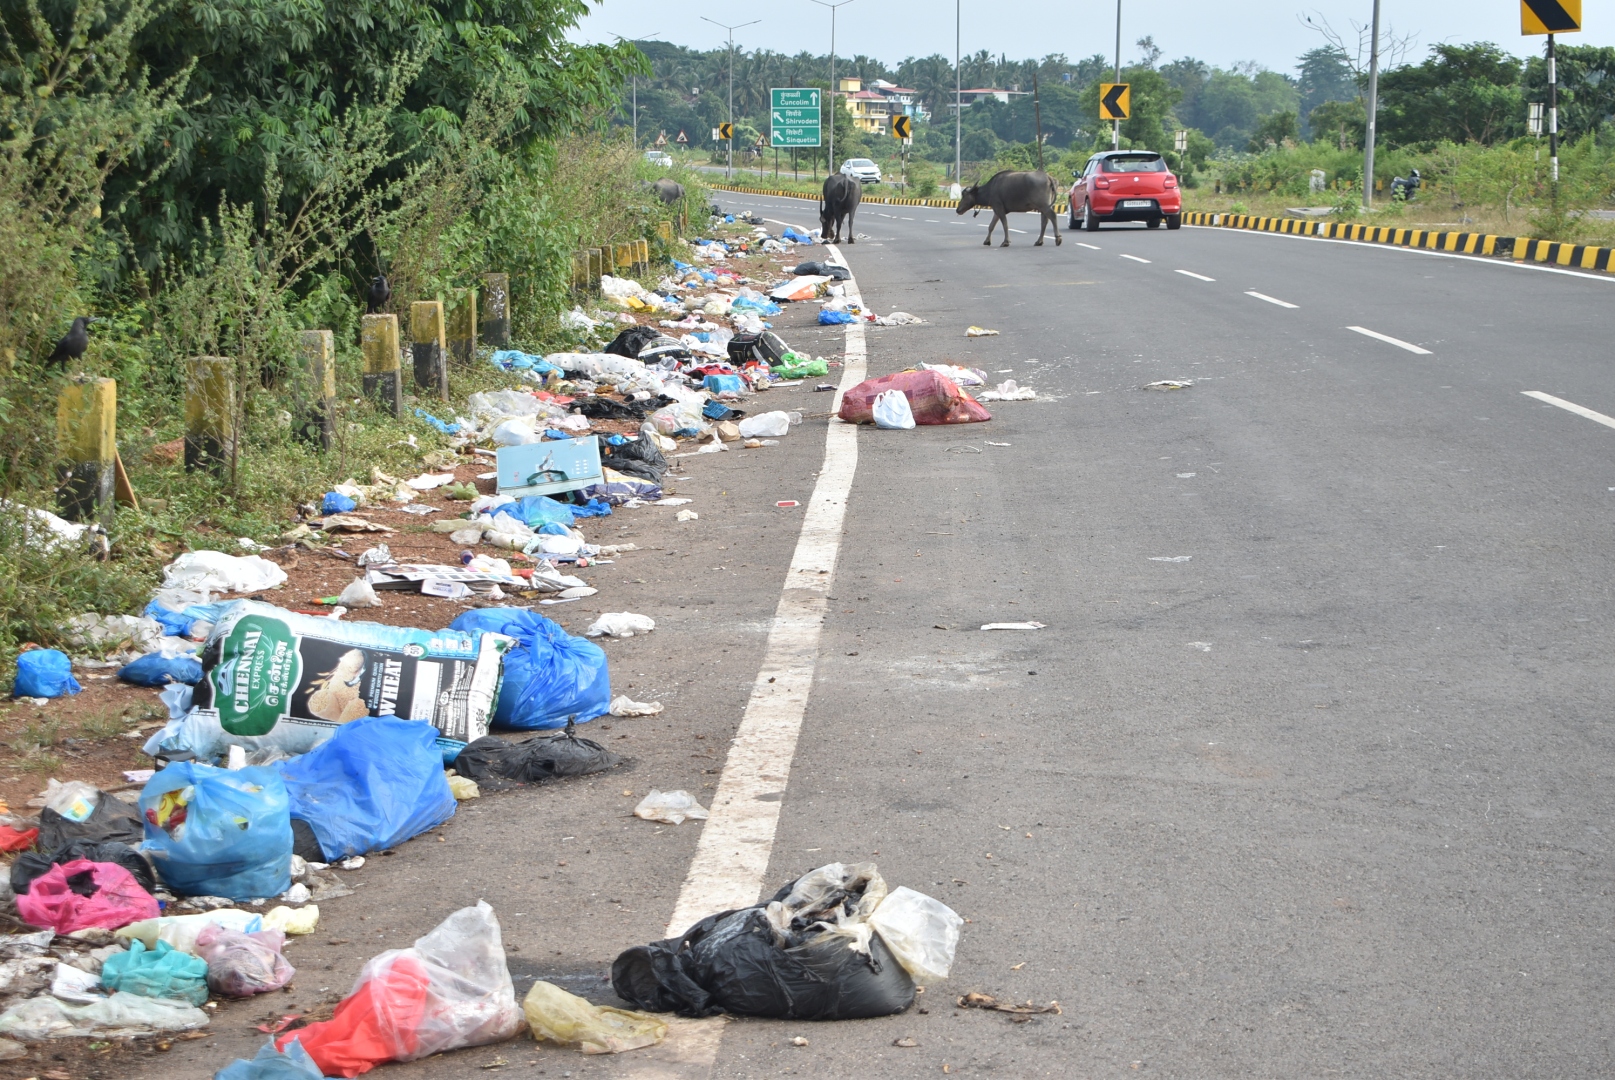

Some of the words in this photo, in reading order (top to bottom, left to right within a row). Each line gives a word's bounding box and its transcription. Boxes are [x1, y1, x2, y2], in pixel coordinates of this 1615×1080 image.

[234, 631, 262, 713] CHENNAI
[252, 650, 265, 689] EXPRESS
[410, 647, 420, 655] 50
[379, 658, 402, 716] WHEAT
